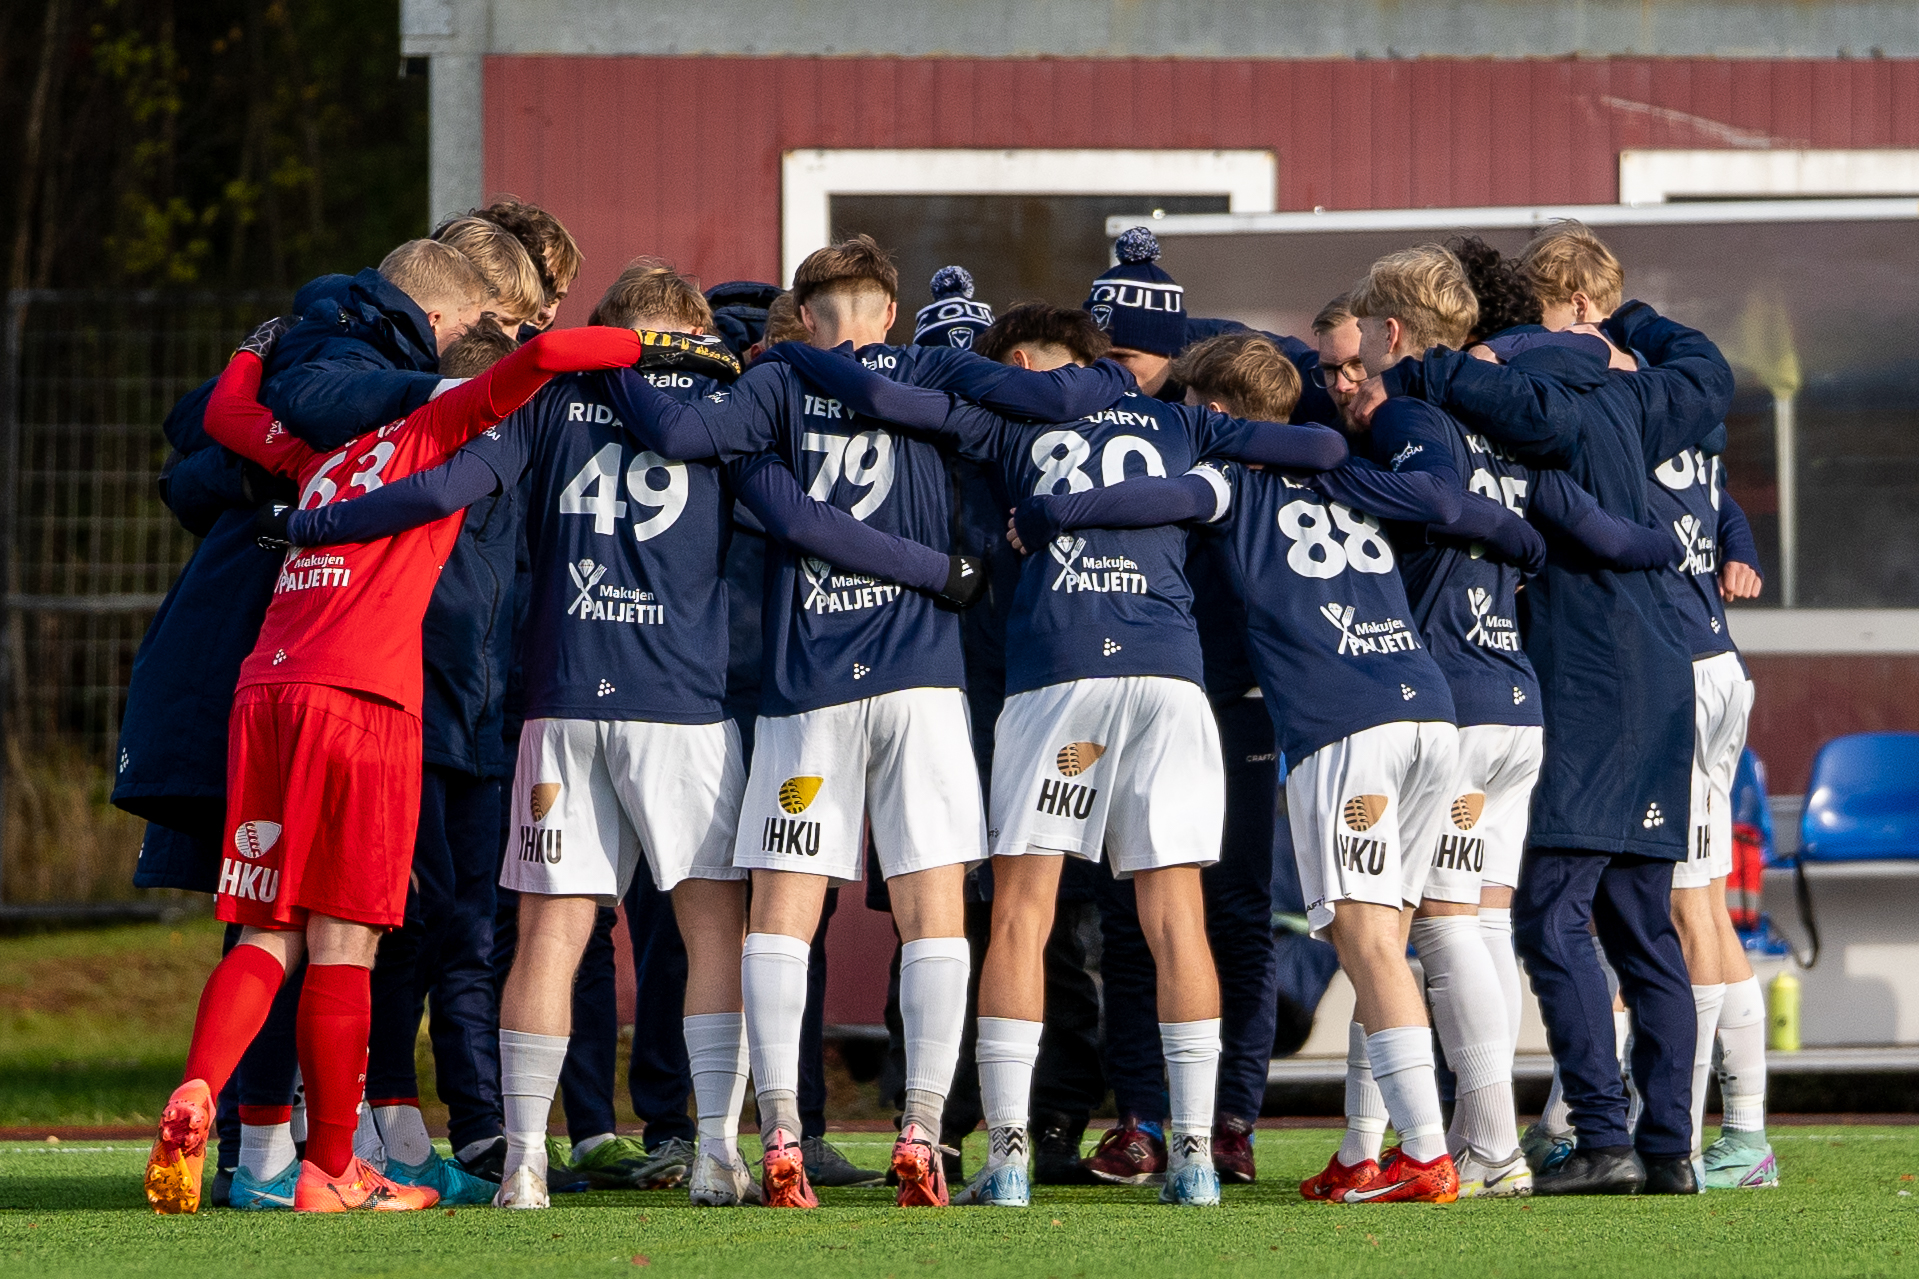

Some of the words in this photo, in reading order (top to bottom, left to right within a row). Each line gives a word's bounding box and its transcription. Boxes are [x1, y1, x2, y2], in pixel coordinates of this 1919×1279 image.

[1094, 286, 1180, 313] OULU
[937, 303, 996, 324] OUL
[862, 354, 897, 371] talo
[644, 373, 694, 388] talo
[1079, 408, 1160, 431] JÄRVI
[801, 429, 896, 522] 79
[1031, 430, 1167, 496] 80
[298, 441, 396, 511] 63
[559, 442, 690, 542] 49
[1277, 500, 1394, 579] 88
[294, 553, 345, 569] Makujen
[1082, 555, 1138, 572] Makujen
[279, 567, 351, 595] PALJETTI
[600, 584, 655, 603] Makujen
[831, 573, 882, 589] Makuj
[1066, 572, 1148, 595] PALJETTI
[580, 600, 664, 625] PALJETTI
[1347, 630, 1422, 656] PALJETT
[1036, 778, 1098, 820] HKU
[218, 857, 279, 903] HKU
